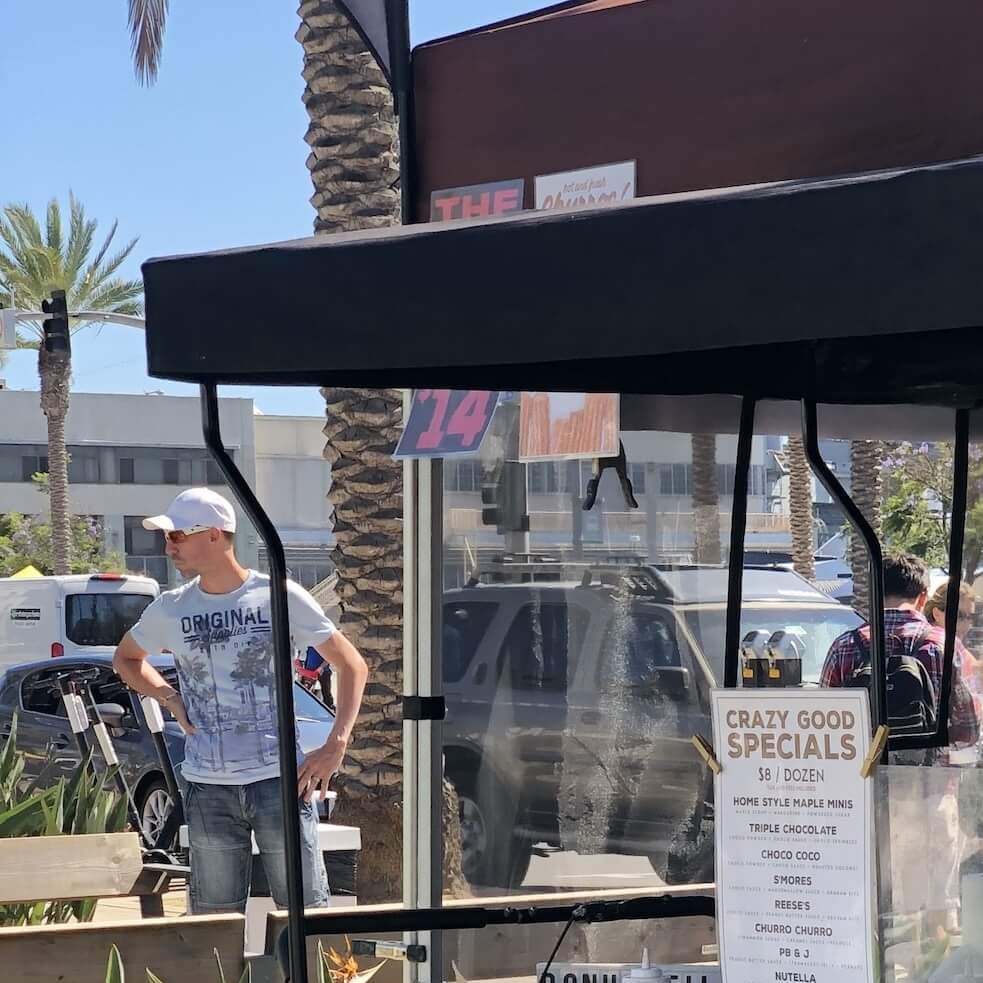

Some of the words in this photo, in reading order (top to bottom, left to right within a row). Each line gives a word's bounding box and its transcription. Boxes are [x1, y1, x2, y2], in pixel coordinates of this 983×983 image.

[181, 606, 269, 634] ORIGINAL
[726, 709, 789, 729] CRAZY
[797, 710, 855, 730] GOOD
[727, 732, 857, 761] SPECIALS
[758, 767, 771, 783] $8
[784, 768, 825, 783] DOZEN
[733, 796, 759, 807] HOME
[762, 797, 790, 808] STYLE
[793, 798, 824, 809] MAPLE
[827, 799, 853, 809] MINIS
[749, 823, 780, 834] TRIPLE
[783, 825, 837, 835] CHOCOLATE
[761, 850, 793, 860] CHOCO
[796, 851, 821, 861] COCO
[773, 875, 812, 886] S'MORES
[775, 900, 811, 911] REESE'S
[755, 923, 792, 935] CHURRO
[795, 926, 833, 937] CHURRO
[779, 947, 791, 958] PB
[794, 948, 801, 958] &
[803, 949, 810, 959] J
[775, 971, 817, 983] NUTELLA
